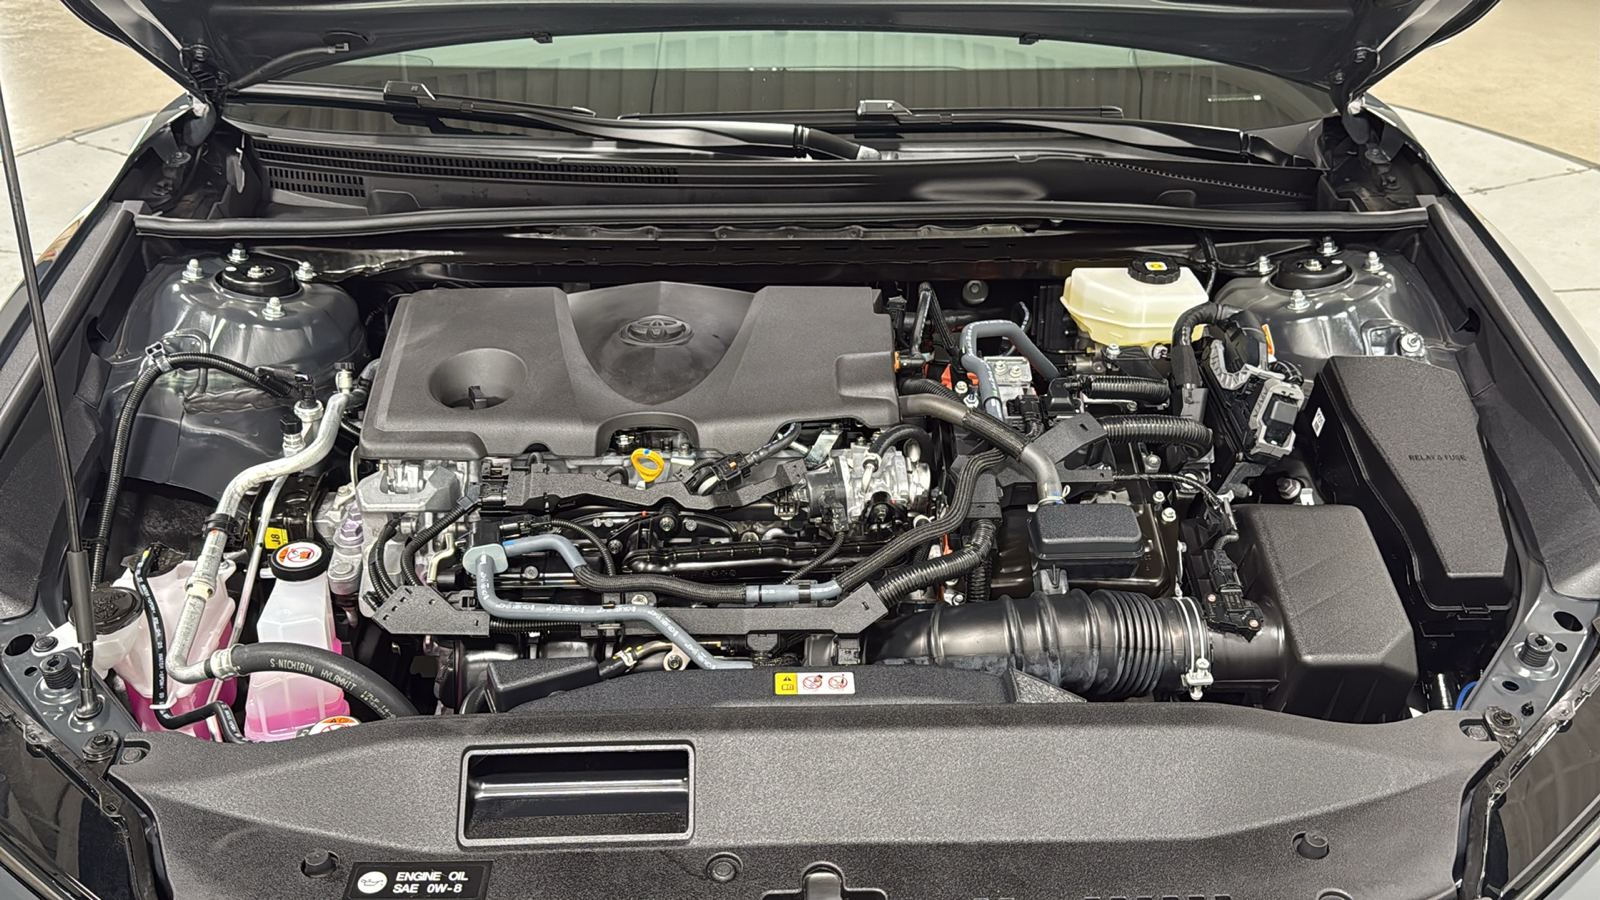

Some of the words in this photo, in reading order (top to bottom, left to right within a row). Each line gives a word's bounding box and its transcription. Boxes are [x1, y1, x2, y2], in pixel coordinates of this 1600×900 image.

[395, 871, 442, 881] ENGINE
[448, 871, 469, 881] OIL
[392, 883, 419, 893] SAE
[426, 883, 463, 893] 0W-8
